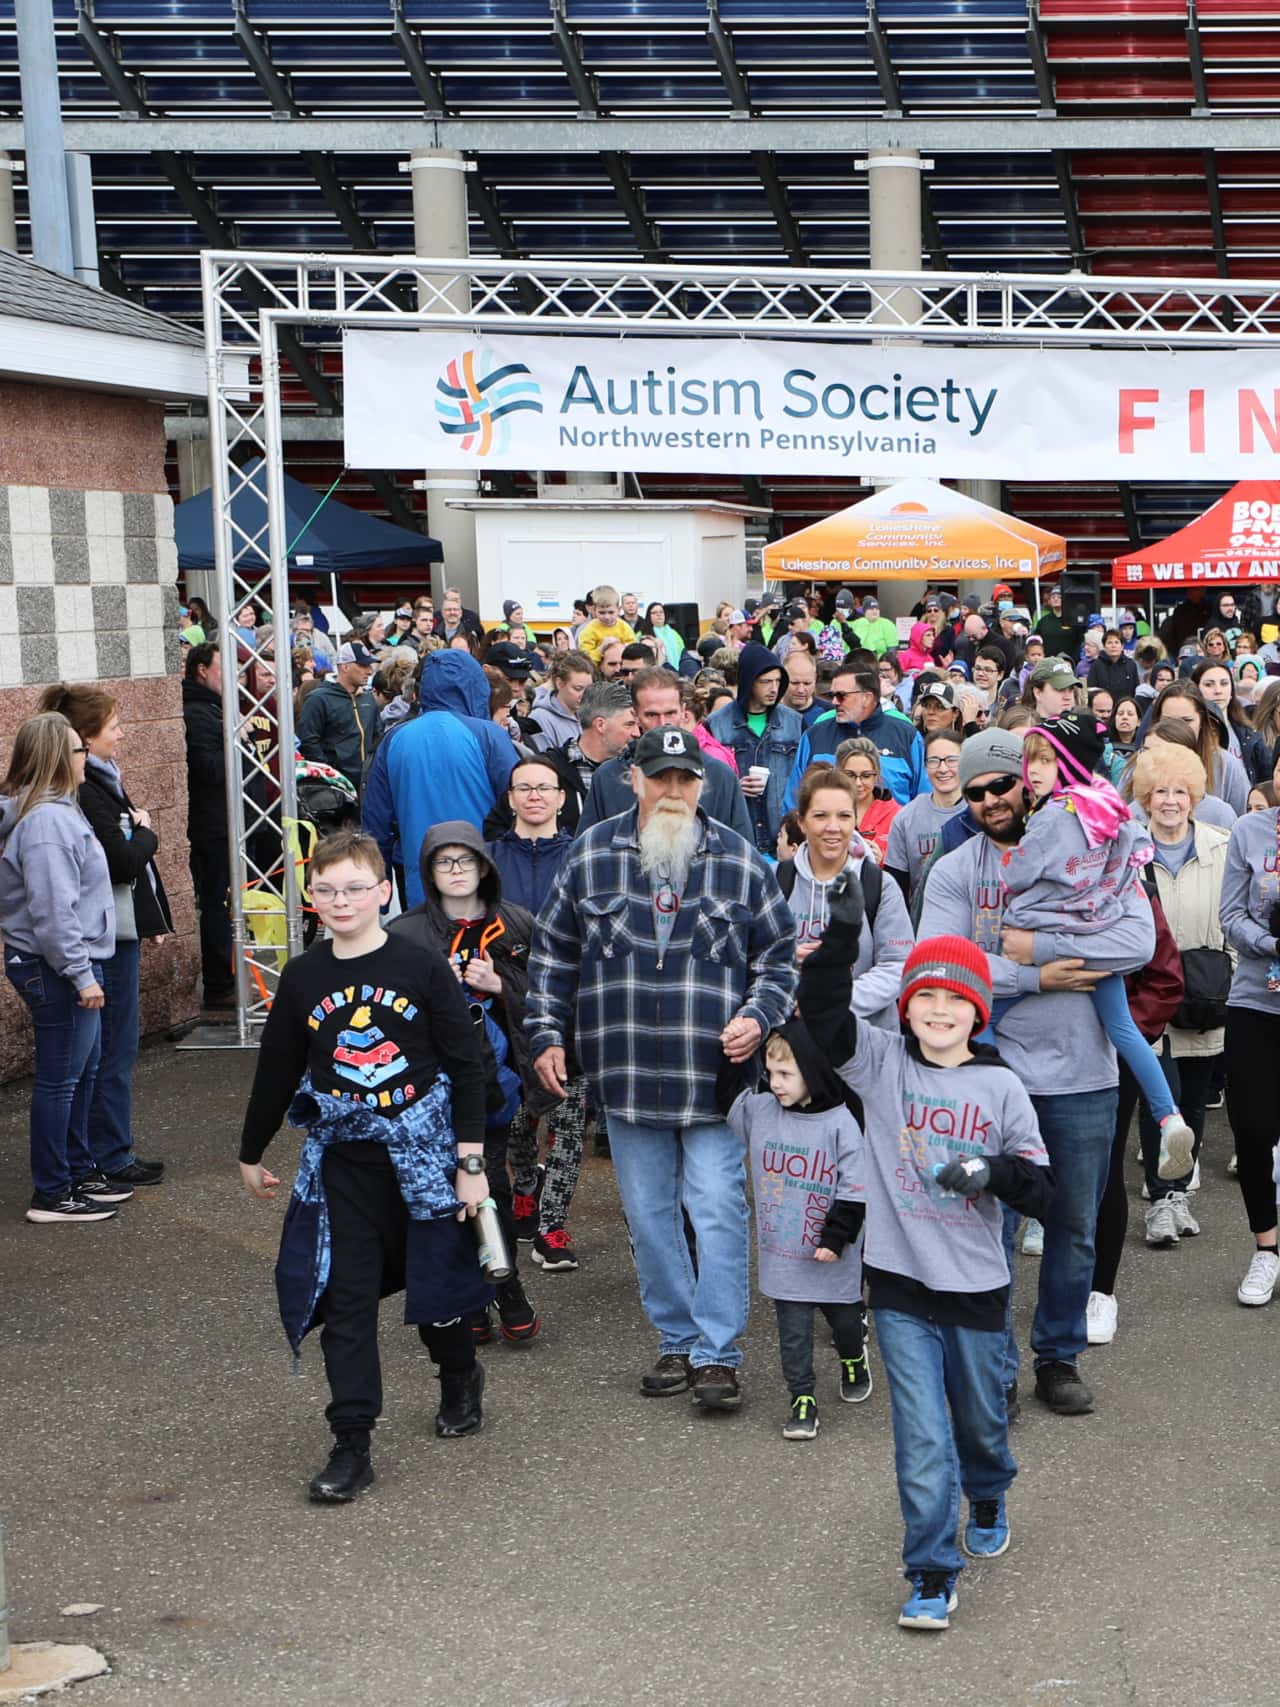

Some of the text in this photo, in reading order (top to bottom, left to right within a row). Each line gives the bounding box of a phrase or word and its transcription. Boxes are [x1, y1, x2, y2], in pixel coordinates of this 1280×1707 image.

[560, 365, 998, 437] Autism Society
[559, 425, 937, 457] Northwestern Pennsylvania
[781, 557, 850, 571] Lakeshore
[853, 556, 928, 571] Community
[929, 555, 992, 571] Services,
[1152, 562, 1185, 580] WE
[1191, 561, 1241, 579] PLAY
[307, 984, 419, 1031] EVERY PIECE
[906, 1102, 993, 1145] walk
[762, 1149, 837, 1185] walk
[801, 1192, 831, 1249] 2022
